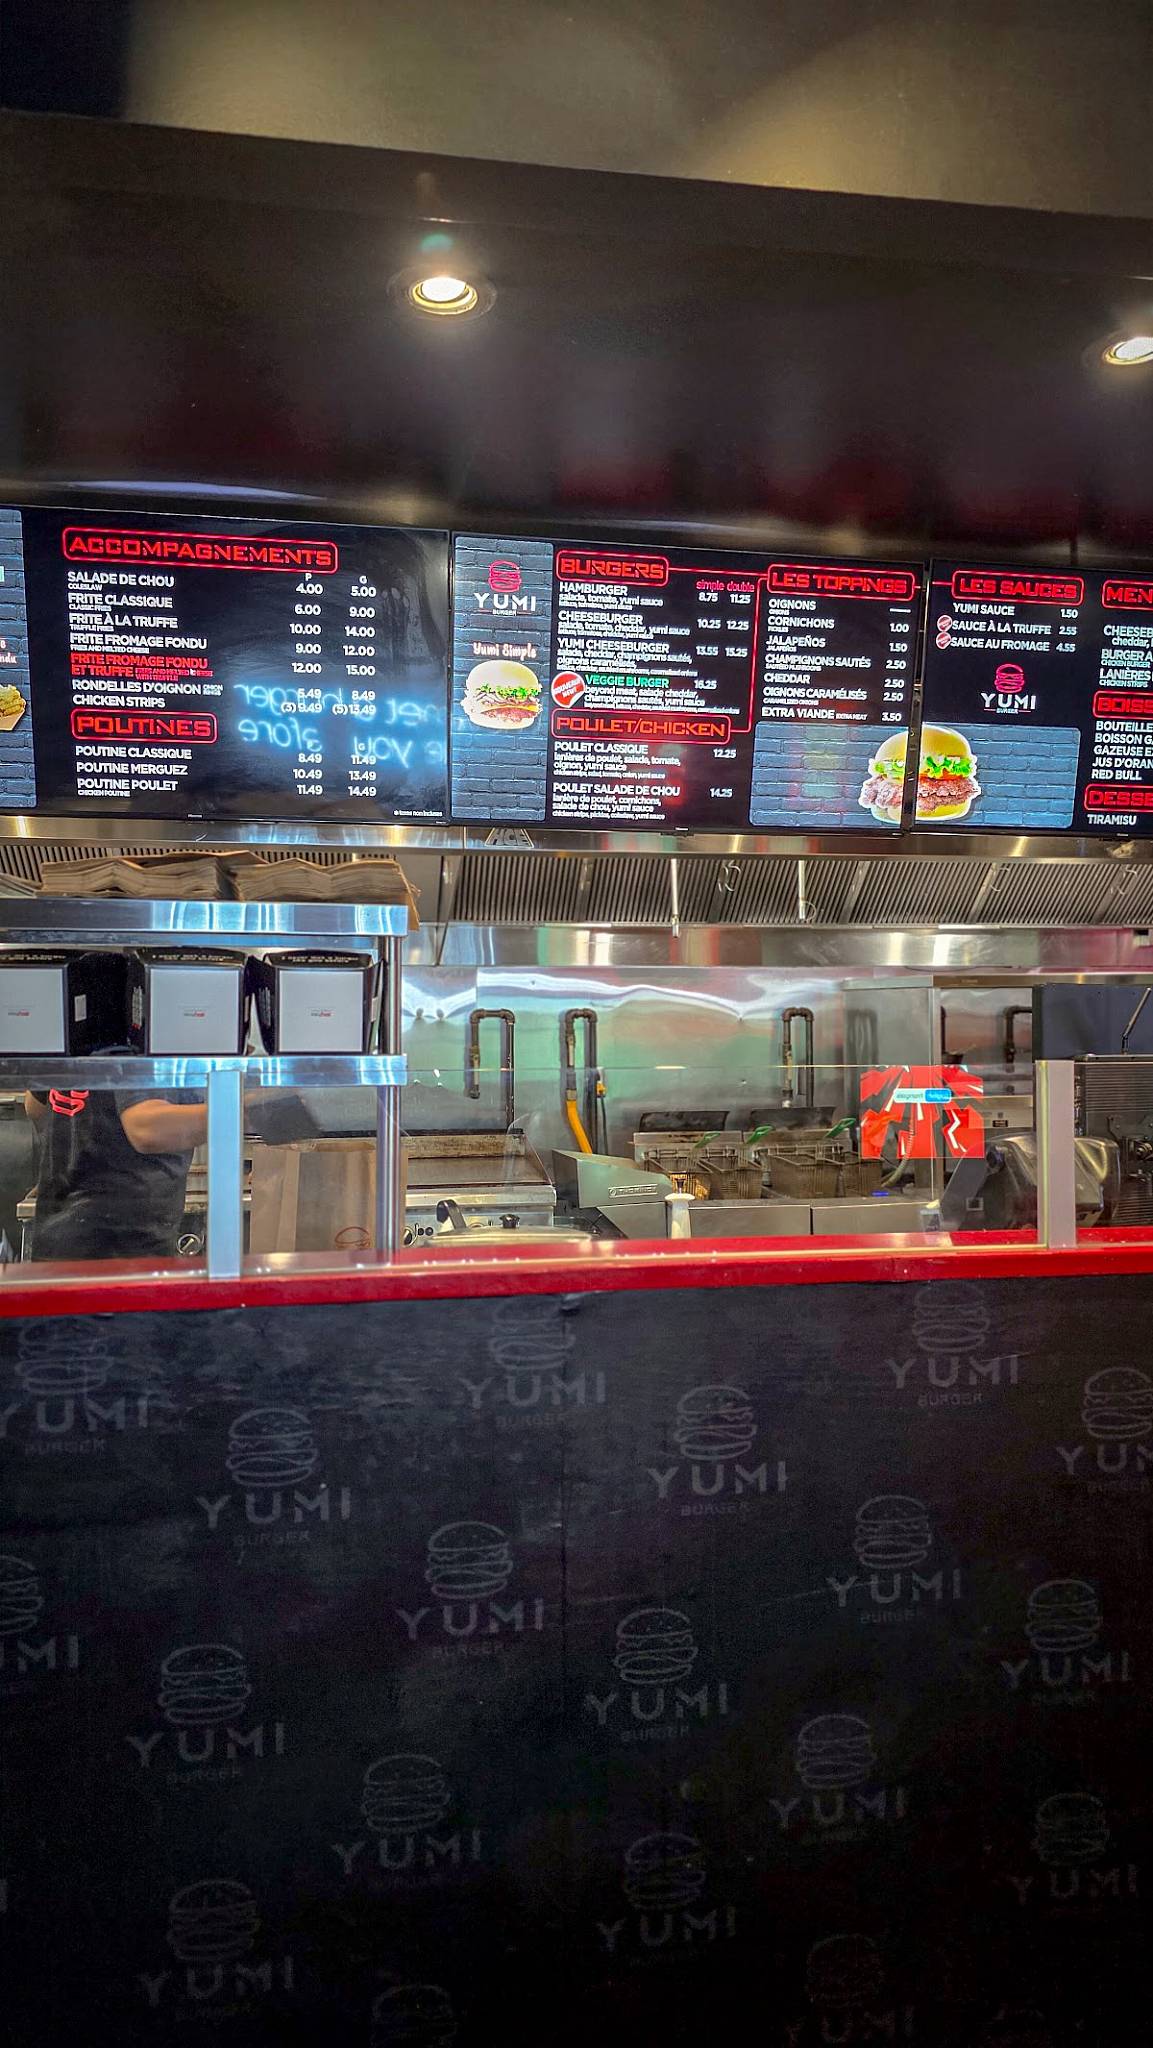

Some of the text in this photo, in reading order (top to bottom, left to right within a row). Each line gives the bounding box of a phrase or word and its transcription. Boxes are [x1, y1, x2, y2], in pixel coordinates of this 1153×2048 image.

[69, 536, 332, 566] ACCOMPAGNEMENTS
[560, 558, 664, 579] BURGERS
[67, 571, 175, 587] SALADE DE CHOU
[305, 573, 312, 581] P
[359, 576, 368, 584] G
[772, 572, 907, 594] LES TOPPINGS
[296, 584, 324, 595] 4.00
[350, 586, 376, 598] 5.00
[560, 582, 628, 596] HAMBURGER
[696, 580, 755, 593] simple double
[960, 578, 1078, 599] LES SAUCES
[68, 592, 173, 608] FRITE CLASSIQUE
[474, 592, 536, 612] YUMI
[620, 596, 640, 606] yumi
[640, 599, 664, 607] sauce
[698, 592, 718, 602] 8.75
[730, 594, 751, 604] 11.25
[294, 604, 322, 616] 6.00
[768, 599, 817, 611] OIGNONS
[953, 602, 1016, 616] YUMI SAUCE
[349, 607, 376, 618] 9.00
[558, 610, 644, 626] CHEESEBURGER
[1060, 608, 1078, 618] 1.50
[69, 612, 178, 628] FRITE À LA TRUFFE
[697, 618, 721, 629] 10.25
[726, 620, 750, 631] 12.25
[768, 616, 835, 630] CORNICHONS
[290, 624, 322, 635] 10.00
[344, 626, 376, 638] 14.00
[890, 622, 910, 633] 1.00
[952, 620, 986, 632] SAUCE
[987, 619, 996, 632] À
[996, 622, 1012, 633] LA
[1012, 624, 1052, 635] TRUFFE
[1058, 626, 1077, 636] 2.55
[70, 632, 208, 649] FRITE FROMAGE FONDU
[558, 638, 670, 654] YUMI CHEESEBURGER
[766, 634, 826, 648] JALAPEÑOS
[889, 642, 908, 652] 1.50
[950, 637, 984, 648] SAUCE
[985, 638, 1000, 650] AU
[1001, 640, 1050, 652] FROMAGE
[1112, 636, 1150, 649] cheddar,
[296, 643, 322, 654] 9.00
[343, 646, 376, 657] 12.00
[473, 642, 500, 656] Yumi
[696, 645, 718, 656] 13.55
[724, 647, 748, 658] 15.25
[1056, 644, 1076, 652] 4.55
[1101, 648, 1145, 661] BURGER
[71, 652, 208, 669] FRITE FROMAGE FONDU
[765, 654, 872, 668] CHAMPIGNONS SAUTÉS
[886, 660, 906, 670] 2.50
[72, 664, 87, 676] ET
[88, 665, 134, 677] TRUFFE
[292, 662, 322, 674] 12.00
[346, 665, 376, 676] 15.00
[1100, 666, 1152, 680] LANIÈRES
[585, 674, 670, 688] VEGGIE BURGER
[764, 673, 810, 684] CHEDDAR
[884, 678, 905, 688] 2.50
[72, 680, 202, 694] RONDELLES D'OIGNON
[763, 687, 868, 700] OIGNONS CARAMÉLISÉS
[73, 695, 166, 708] CHICKEN STRIPS
[351, 690, 376, 701] 8.49
[883, 692, 904, 702] 2.50
[980, 692, 1036, 710] YUMI
[281, 704, 296, 714] (3)
[332, 704, 376, 716] (5) 13.49
[762, 707, 835, 719] EXTRA VIANDE
[882, 712, 902, 722] 3.50
[77, 716, 211, 736] POUTINES
[556, 716, 726, 736] POULET/CHICKEN
[1094, 732, 1142, 745] BOISSON
[76, 746, 192, 759] POUTINE CLASSIQUE
[554, 742, 648, 754] POULET CLASSIQUE
[713, 748, 736, 758] 12.25
[1094, 745, 1144, 757] GAZEUSE
[298, 753, 322, 764] 8.49
[351, 755, 376, 765] 11.49
[1092, 757, 1112, 768] JUS
[76, 762, 188, 776] POUTINE MERGUEZ
[293, 769, 322, 780] 10.49
[1092, 769, 1142, 780] RED BULL
[349, 771, 376, 781] 13.49
[77, 778, 178, 791] POUTINE POULET
[296, 784, 323, 795] 11.49
[553, 783, 680, 796] POULET SALADE DE CHOU
[348, 786, 376, 797] 14.49
[710, 788, 733, 798] 14.25
[1087, 814, 1137, 826] TIRAMISU
[884, 1353, 1020, 1390] YUMI
[459, 1370, 607, 1410] YUMI
[646, 1460, 788, 1500] YUMI
[195, 1486, 352, 1530] YUMI
[826, 1567, 962, 1608] YUMI
[395, 1597, 545, 1640] YUMI
[1001, 1650, 1132, 1691] YUMI
[584, 1682, 729, 1726] YUMI
[122, 1720, 286, 1769] YUMI
[767, 1786, 908, 1830] YUMI
[330, 1827, 482, 1876] YUMI
[595, 1905, 737, 1952] YUMI
[136, 1954, 295, 2009] YUMI
